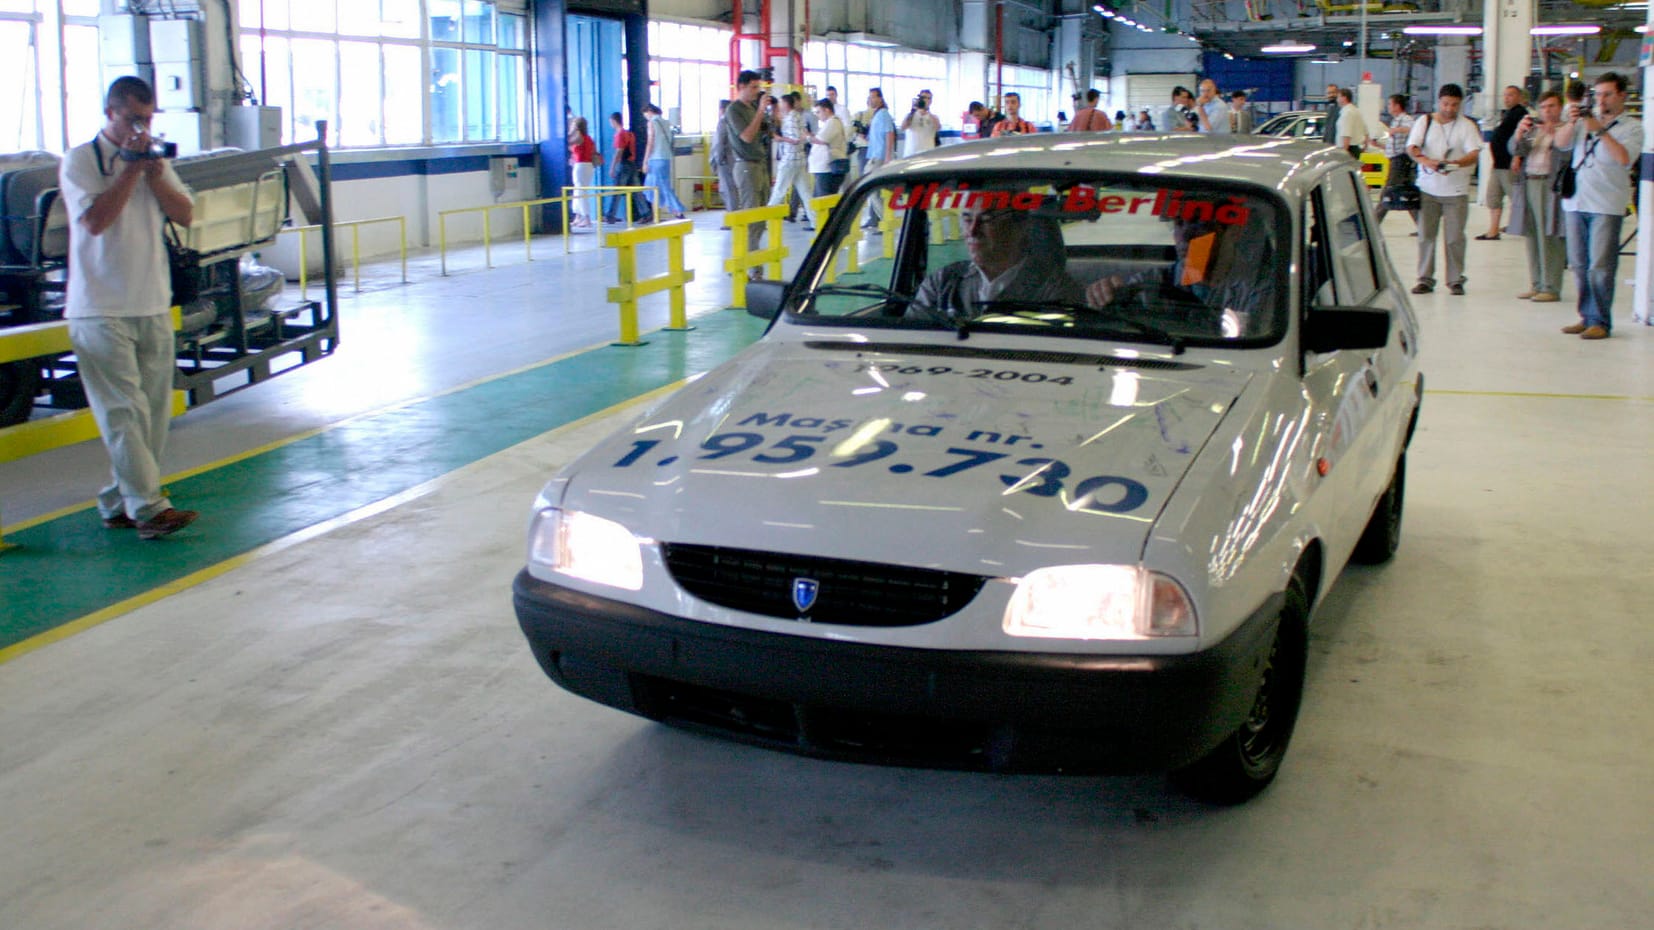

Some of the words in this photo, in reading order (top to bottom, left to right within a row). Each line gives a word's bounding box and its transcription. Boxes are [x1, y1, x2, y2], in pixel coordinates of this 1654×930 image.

[888, 182, 1042, 210] Ultima
[1062, 186, 1250, 226] Berlină
[853, 364, 1075, 386] 1969-2004
[736, 412, 944, 436] Mașa
[965, 430, 1044, 449] nr.
[612, 432, 1149, 513] 1.959.730
